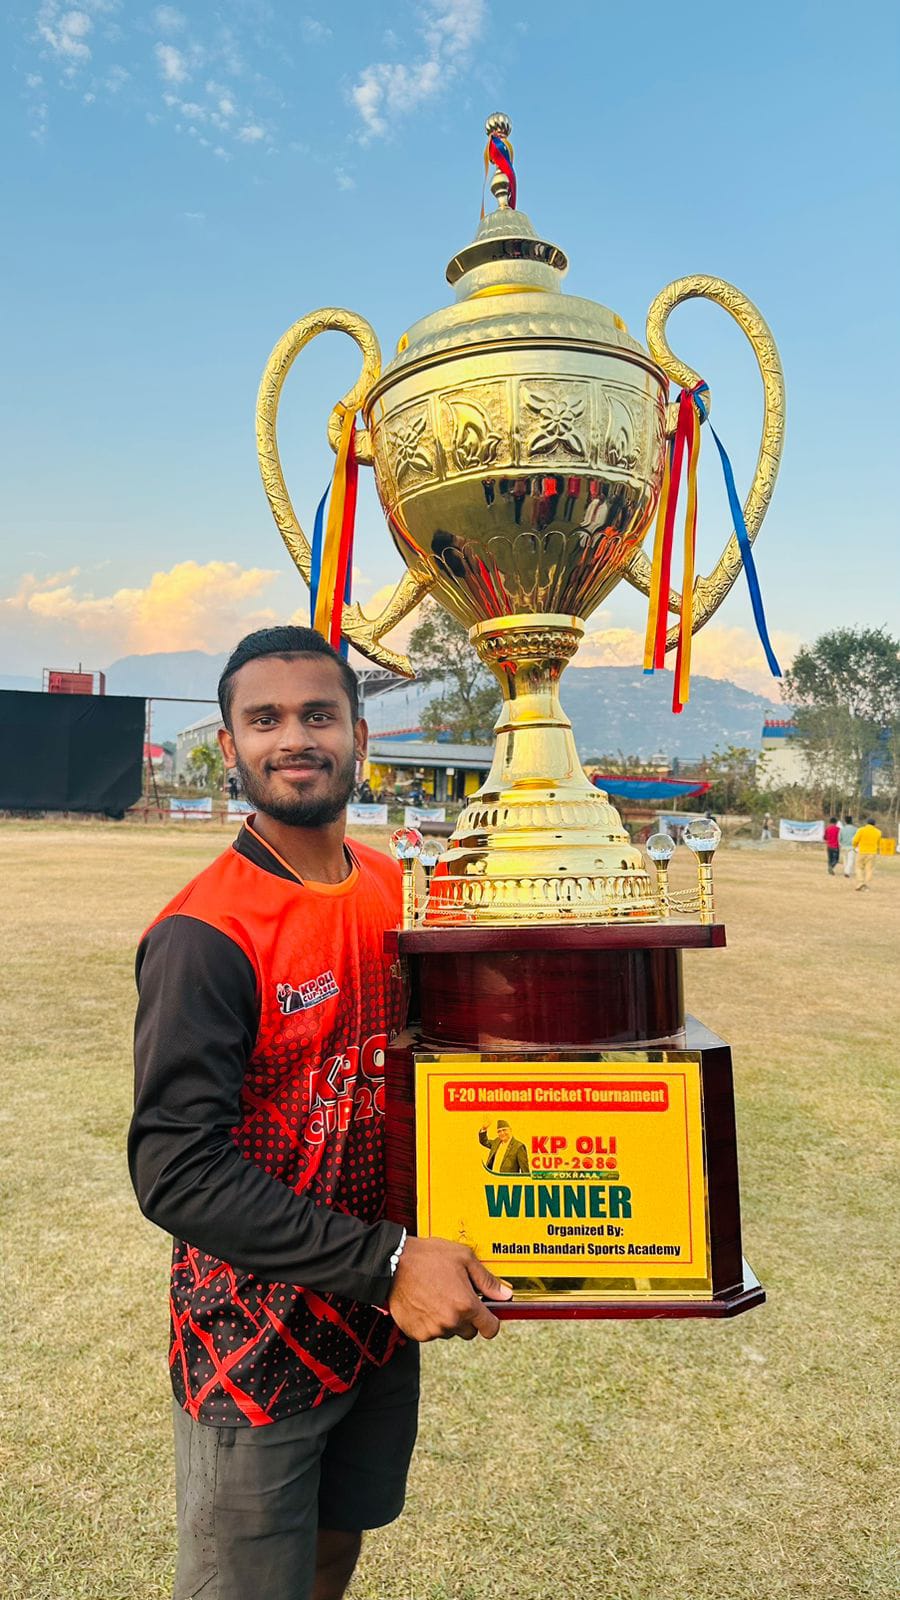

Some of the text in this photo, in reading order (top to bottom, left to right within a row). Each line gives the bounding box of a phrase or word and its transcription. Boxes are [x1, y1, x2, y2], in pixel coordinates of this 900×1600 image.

[301, 972, 333, 995] KP OLI
[308, 1033, 387, 1113] KP O
[448, 1087, 665, 1103] T-20 National Cricket Tournament
[531, 1136, 617, 1154] KP OLI
[531, 1157, 618, 1169] CUP-2080
[484, 1184, 633, 1218] WINNER
[547, 1225, 624, 1237] Organized By:
[492, 1243, 681, 1256] Madan Bhandari Sports Academy
